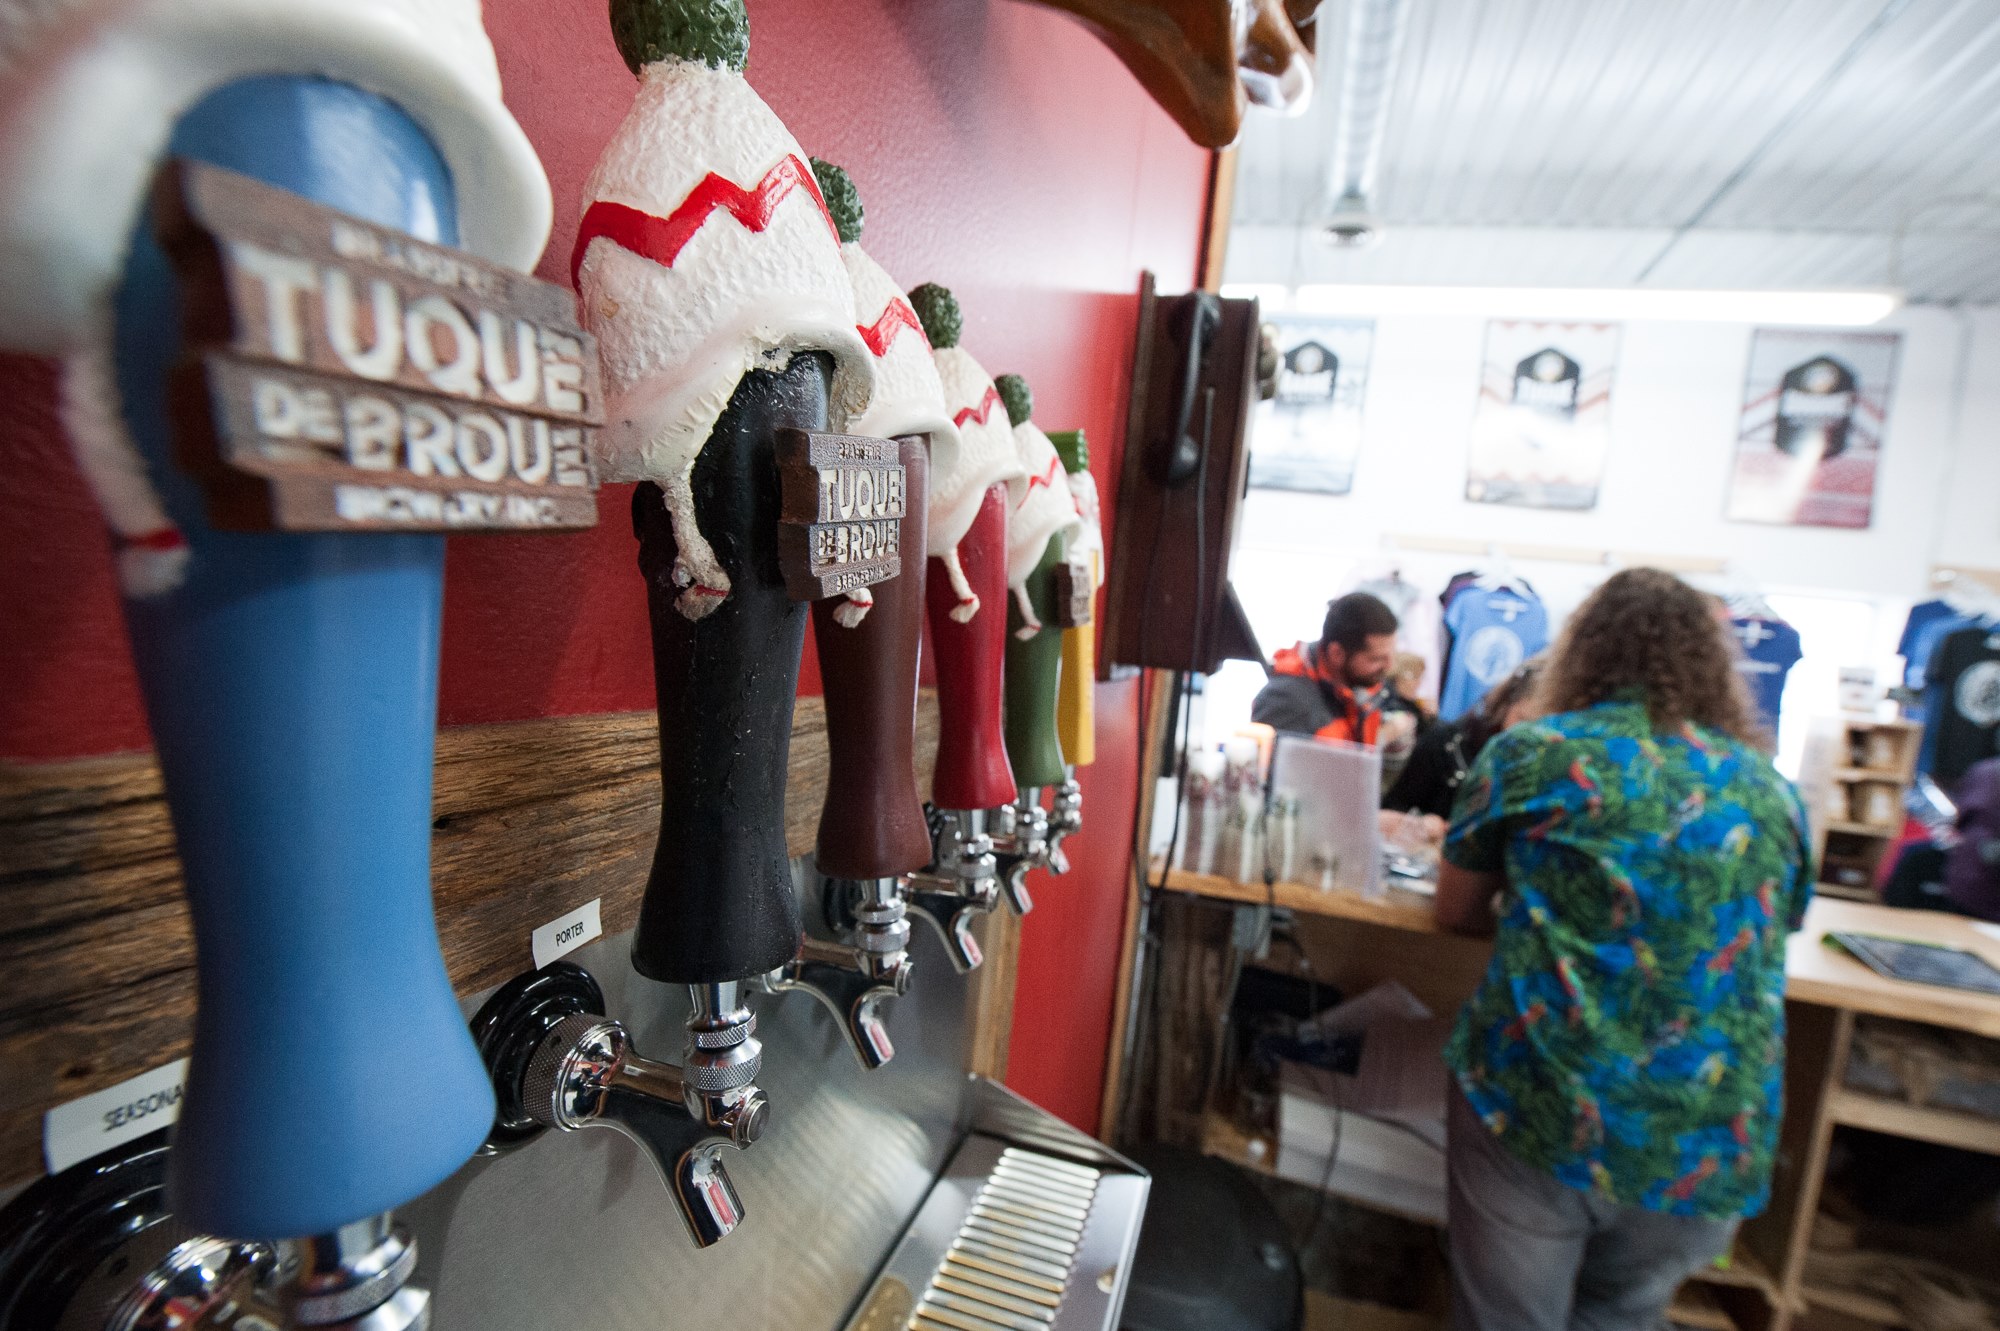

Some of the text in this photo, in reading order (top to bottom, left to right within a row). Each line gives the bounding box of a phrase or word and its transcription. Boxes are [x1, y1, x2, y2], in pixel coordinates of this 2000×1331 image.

[232, 241, 582, 413] TUQUE
[252, 377, 587, 486] DE BROUE
[820, 469, 901, 522] TUQUE
[818, 519, 899, 563] DE BROUE
[555, 921, 585, 947] PORTER
[102, 1083, 184, 1133] SEASONA
